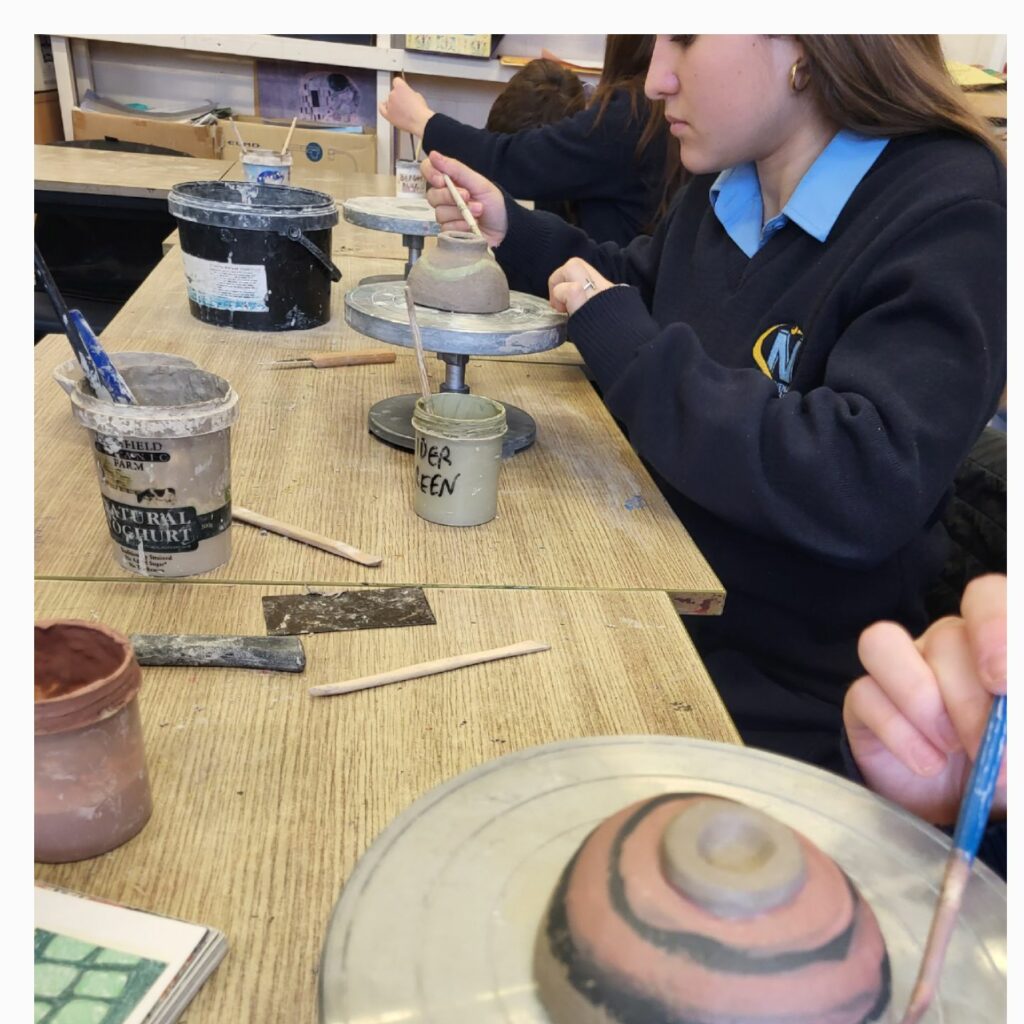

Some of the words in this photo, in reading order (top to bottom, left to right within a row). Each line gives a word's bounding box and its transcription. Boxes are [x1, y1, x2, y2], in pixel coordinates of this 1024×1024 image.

[113, 459, 144, 471] FARM
[417, 438, 452, 469] DER
[416, 466, 461, 497] EEN
[108, 518, 192, 543] OGHURT
